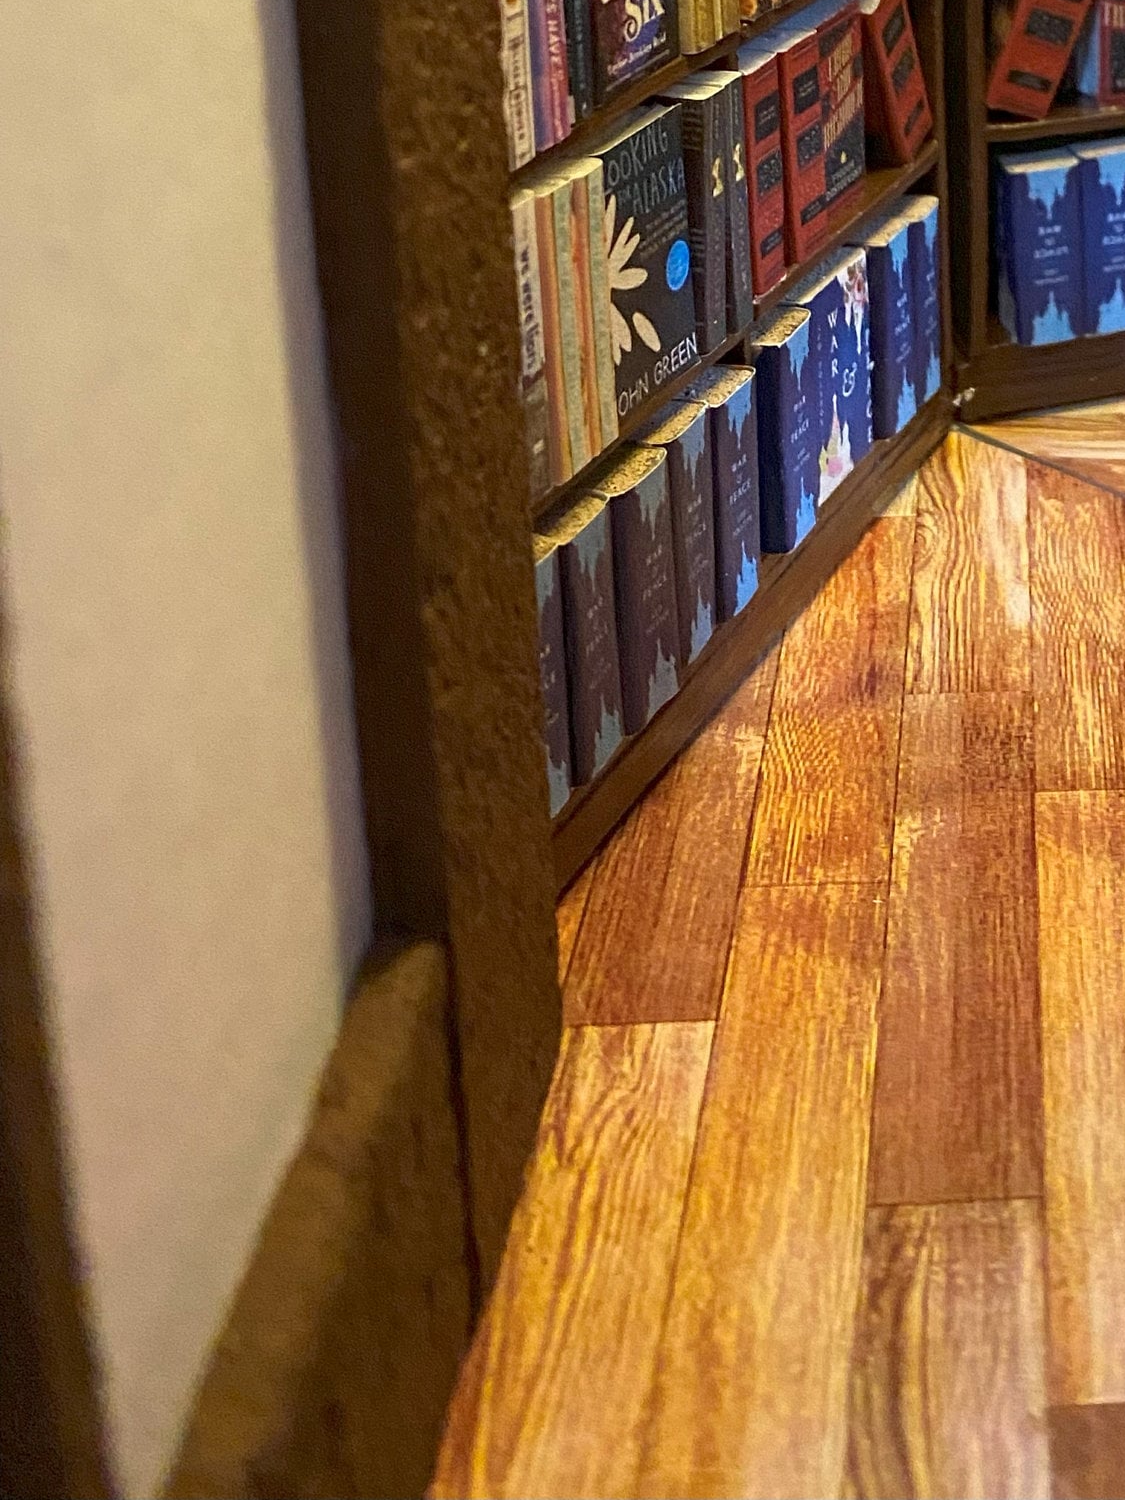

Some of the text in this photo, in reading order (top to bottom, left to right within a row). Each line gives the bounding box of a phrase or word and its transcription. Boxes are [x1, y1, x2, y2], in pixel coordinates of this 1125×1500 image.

[606, 114, 668, 187] OOKING
[633, 156, 686, 214] ALASKA
[521, 249, 531, 276] we
[522, 284, 534, 323] were
[618, 331, 698, 416] OHN GREEN
[843, 360, 858, 398] &
